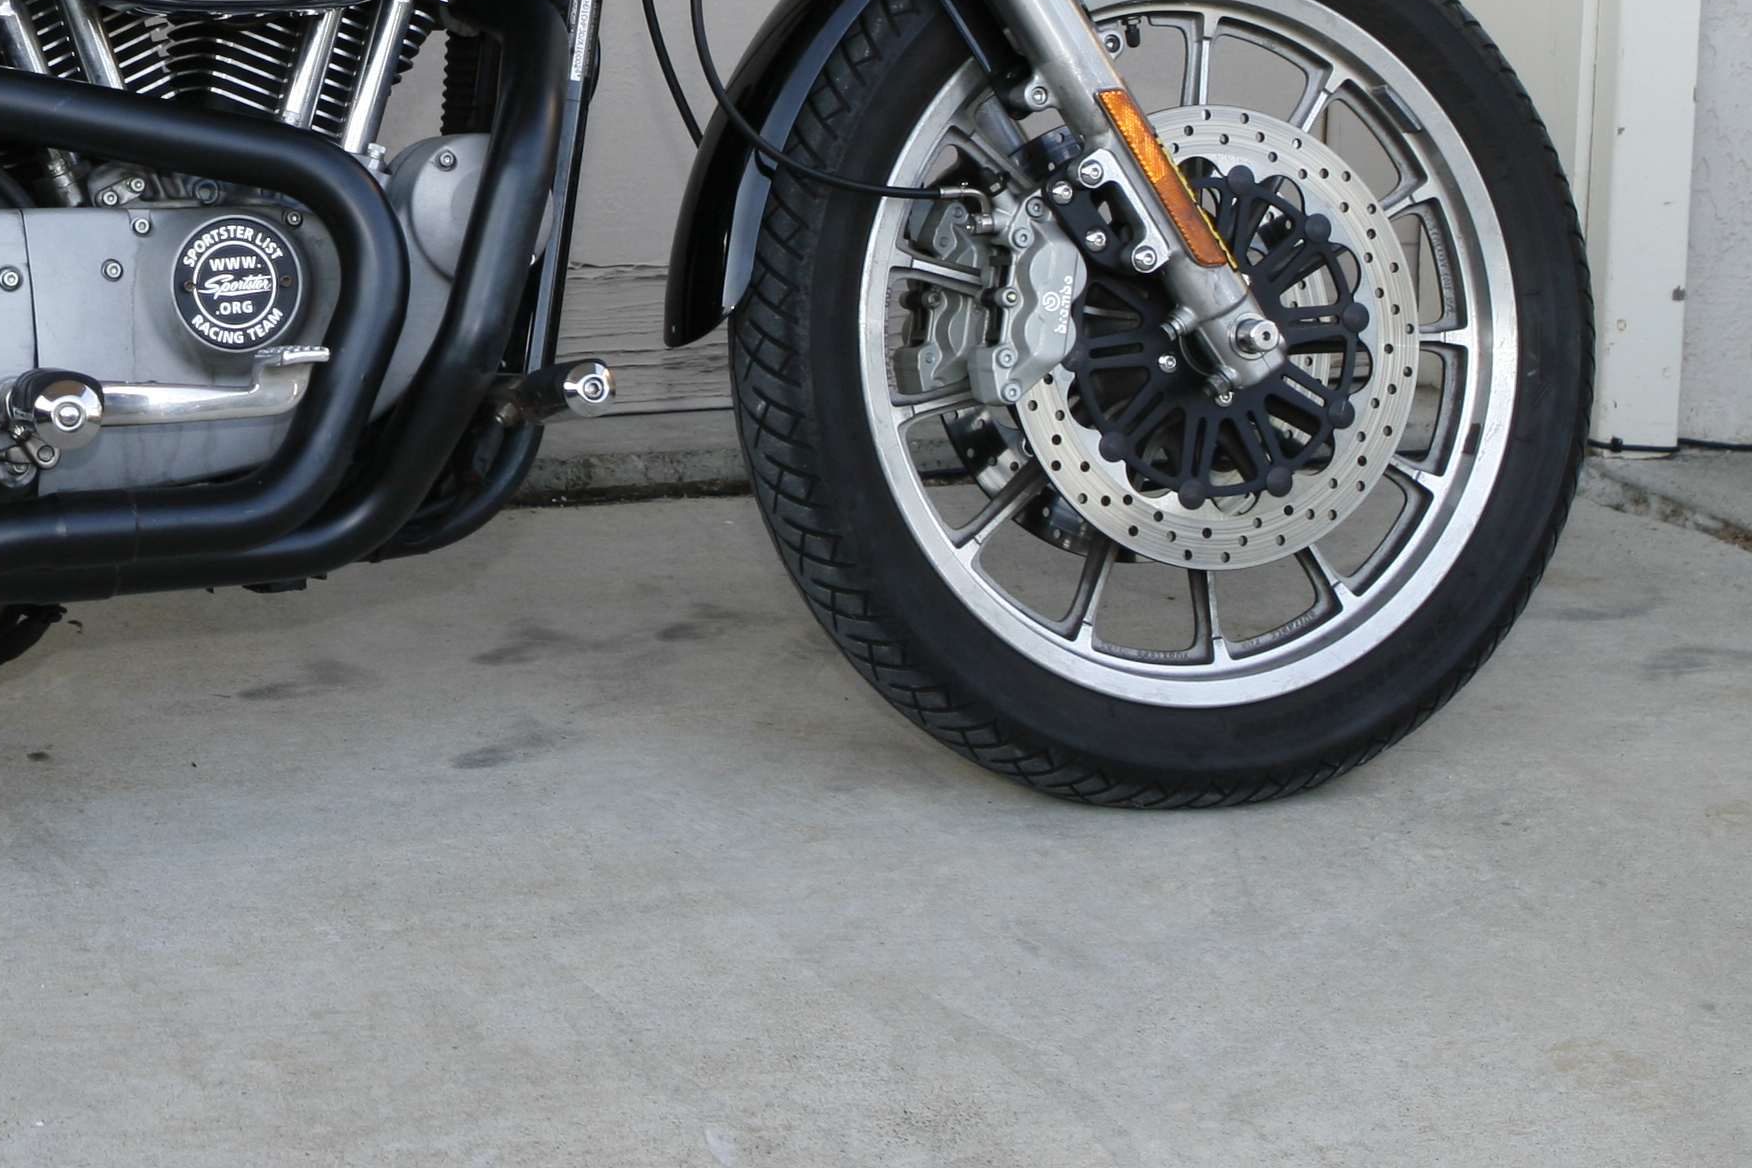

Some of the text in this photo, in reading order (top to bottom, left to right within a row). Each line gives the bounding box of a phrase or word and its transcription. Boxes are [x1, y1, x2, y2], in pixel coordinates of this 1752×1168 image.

[183, 225, 284, 267] SPORTSTER LIST
[209, 256, 262, 271] WWW.
[198, 274, 272, 300] Sportster
[215, 300, 254, 315] .ORG
[191, 307, 284, 344] RACING TEAM
